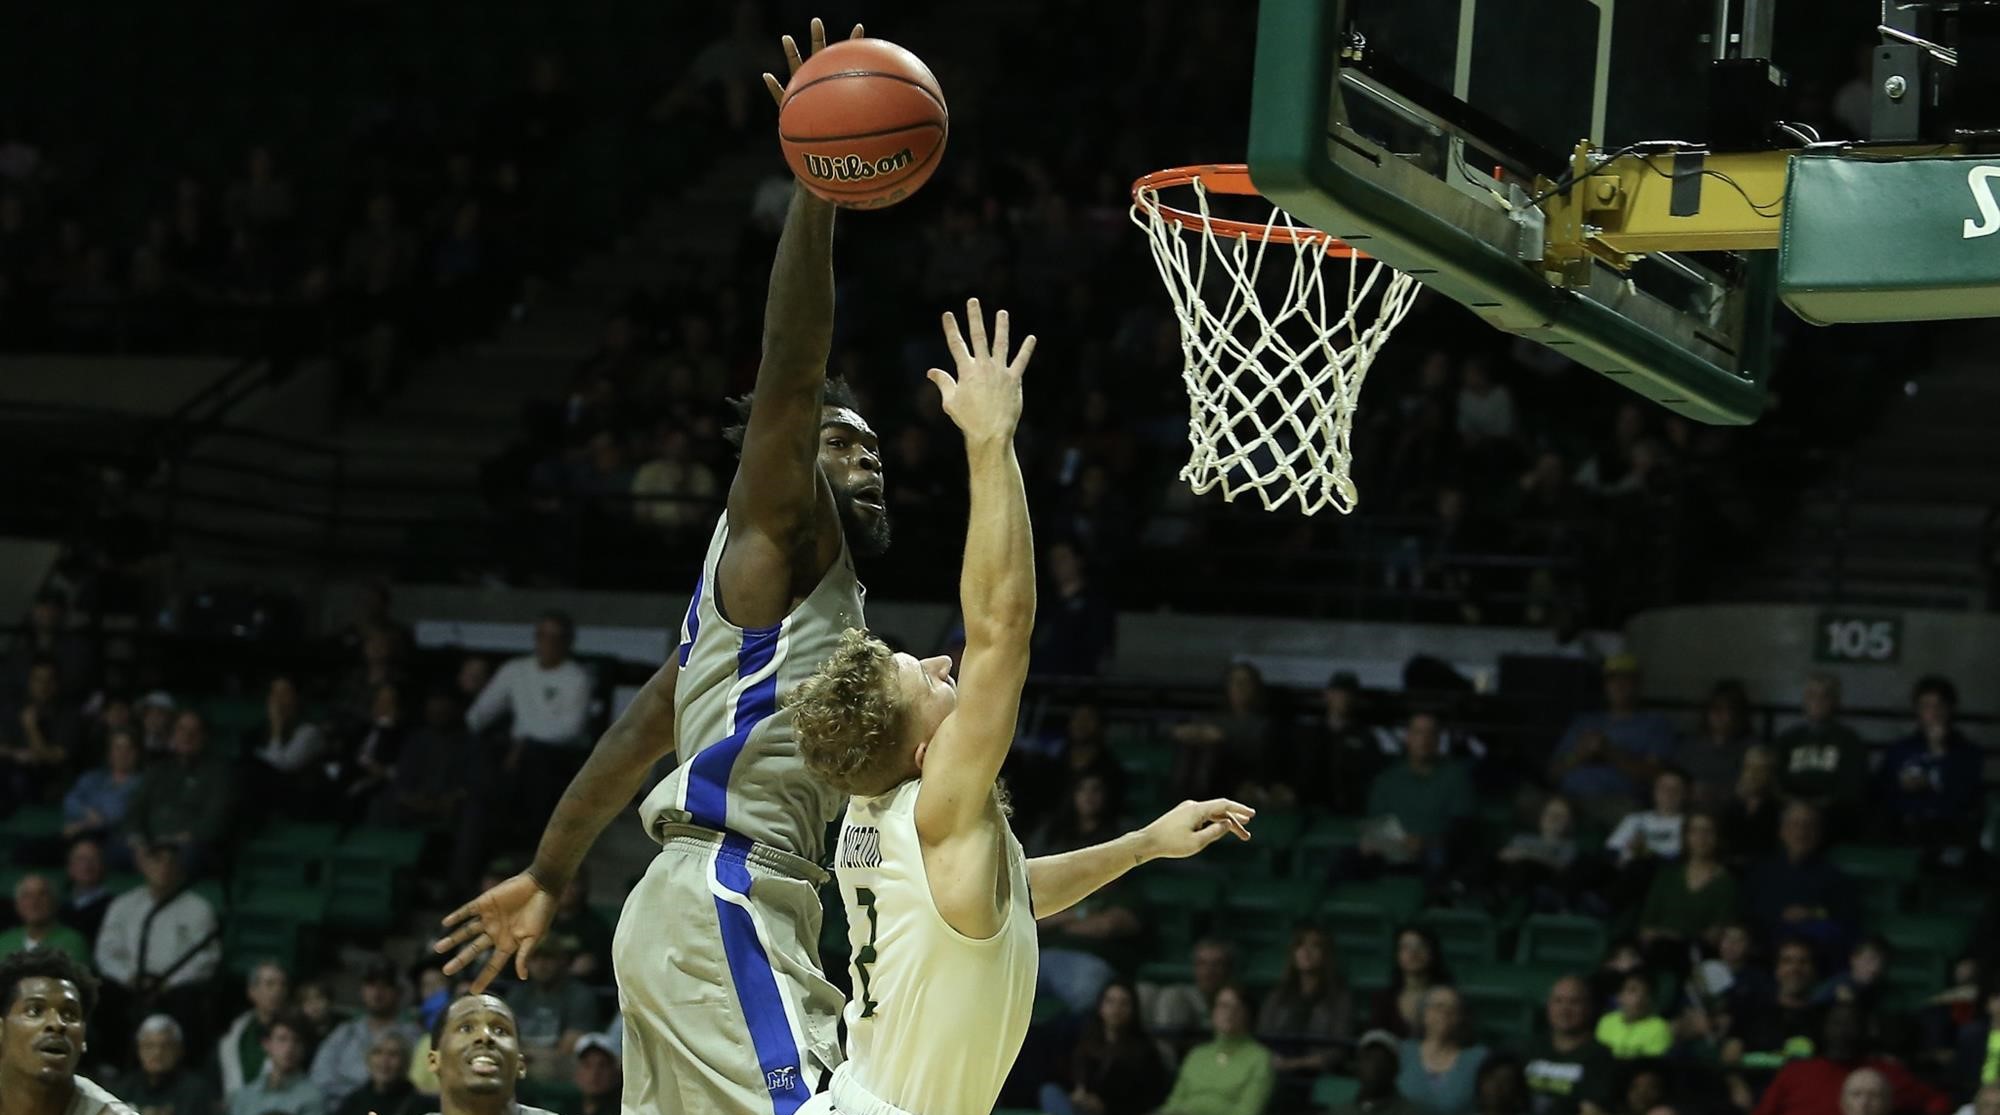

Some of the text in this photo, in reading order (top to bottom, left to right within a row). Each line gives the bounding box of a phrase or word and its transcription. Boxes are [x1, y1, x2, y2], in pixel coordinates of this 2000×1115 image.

[802, 148, 914, 182] Wilson
[1826, 620, 1893, 658] 105
[855, 887, 878, 1018] 2
